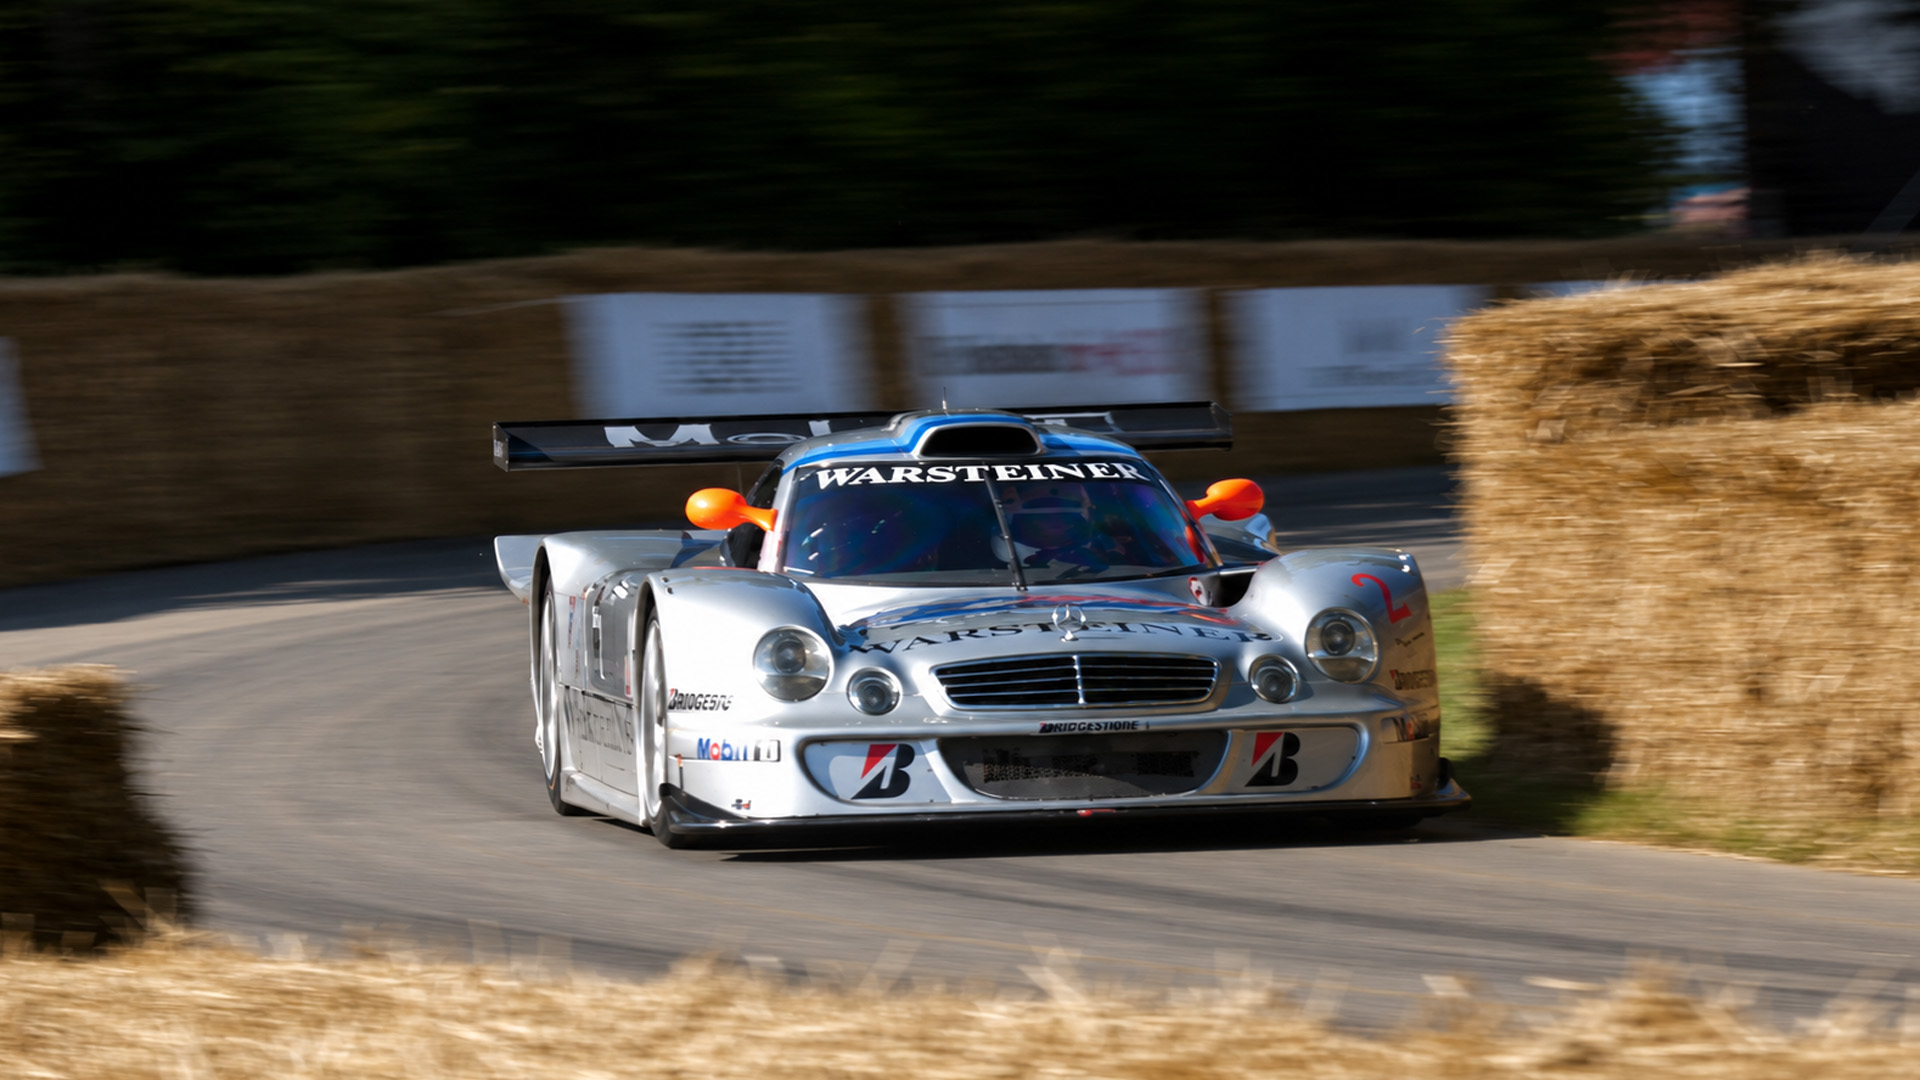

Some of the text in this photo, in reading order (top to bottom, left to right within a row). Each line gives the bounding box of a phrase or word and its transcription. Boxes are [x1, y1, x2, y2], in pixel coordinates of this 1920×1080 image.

[816, 463, 1148, 489] WARSTEINER
[1350, 573, 1412, 624] 2
[848, 622, 1274, 655] WARSTEINER
[1039, 720, 1139, 733] BRIDGESTONE
[697, 737, 748, 761] Mobil
